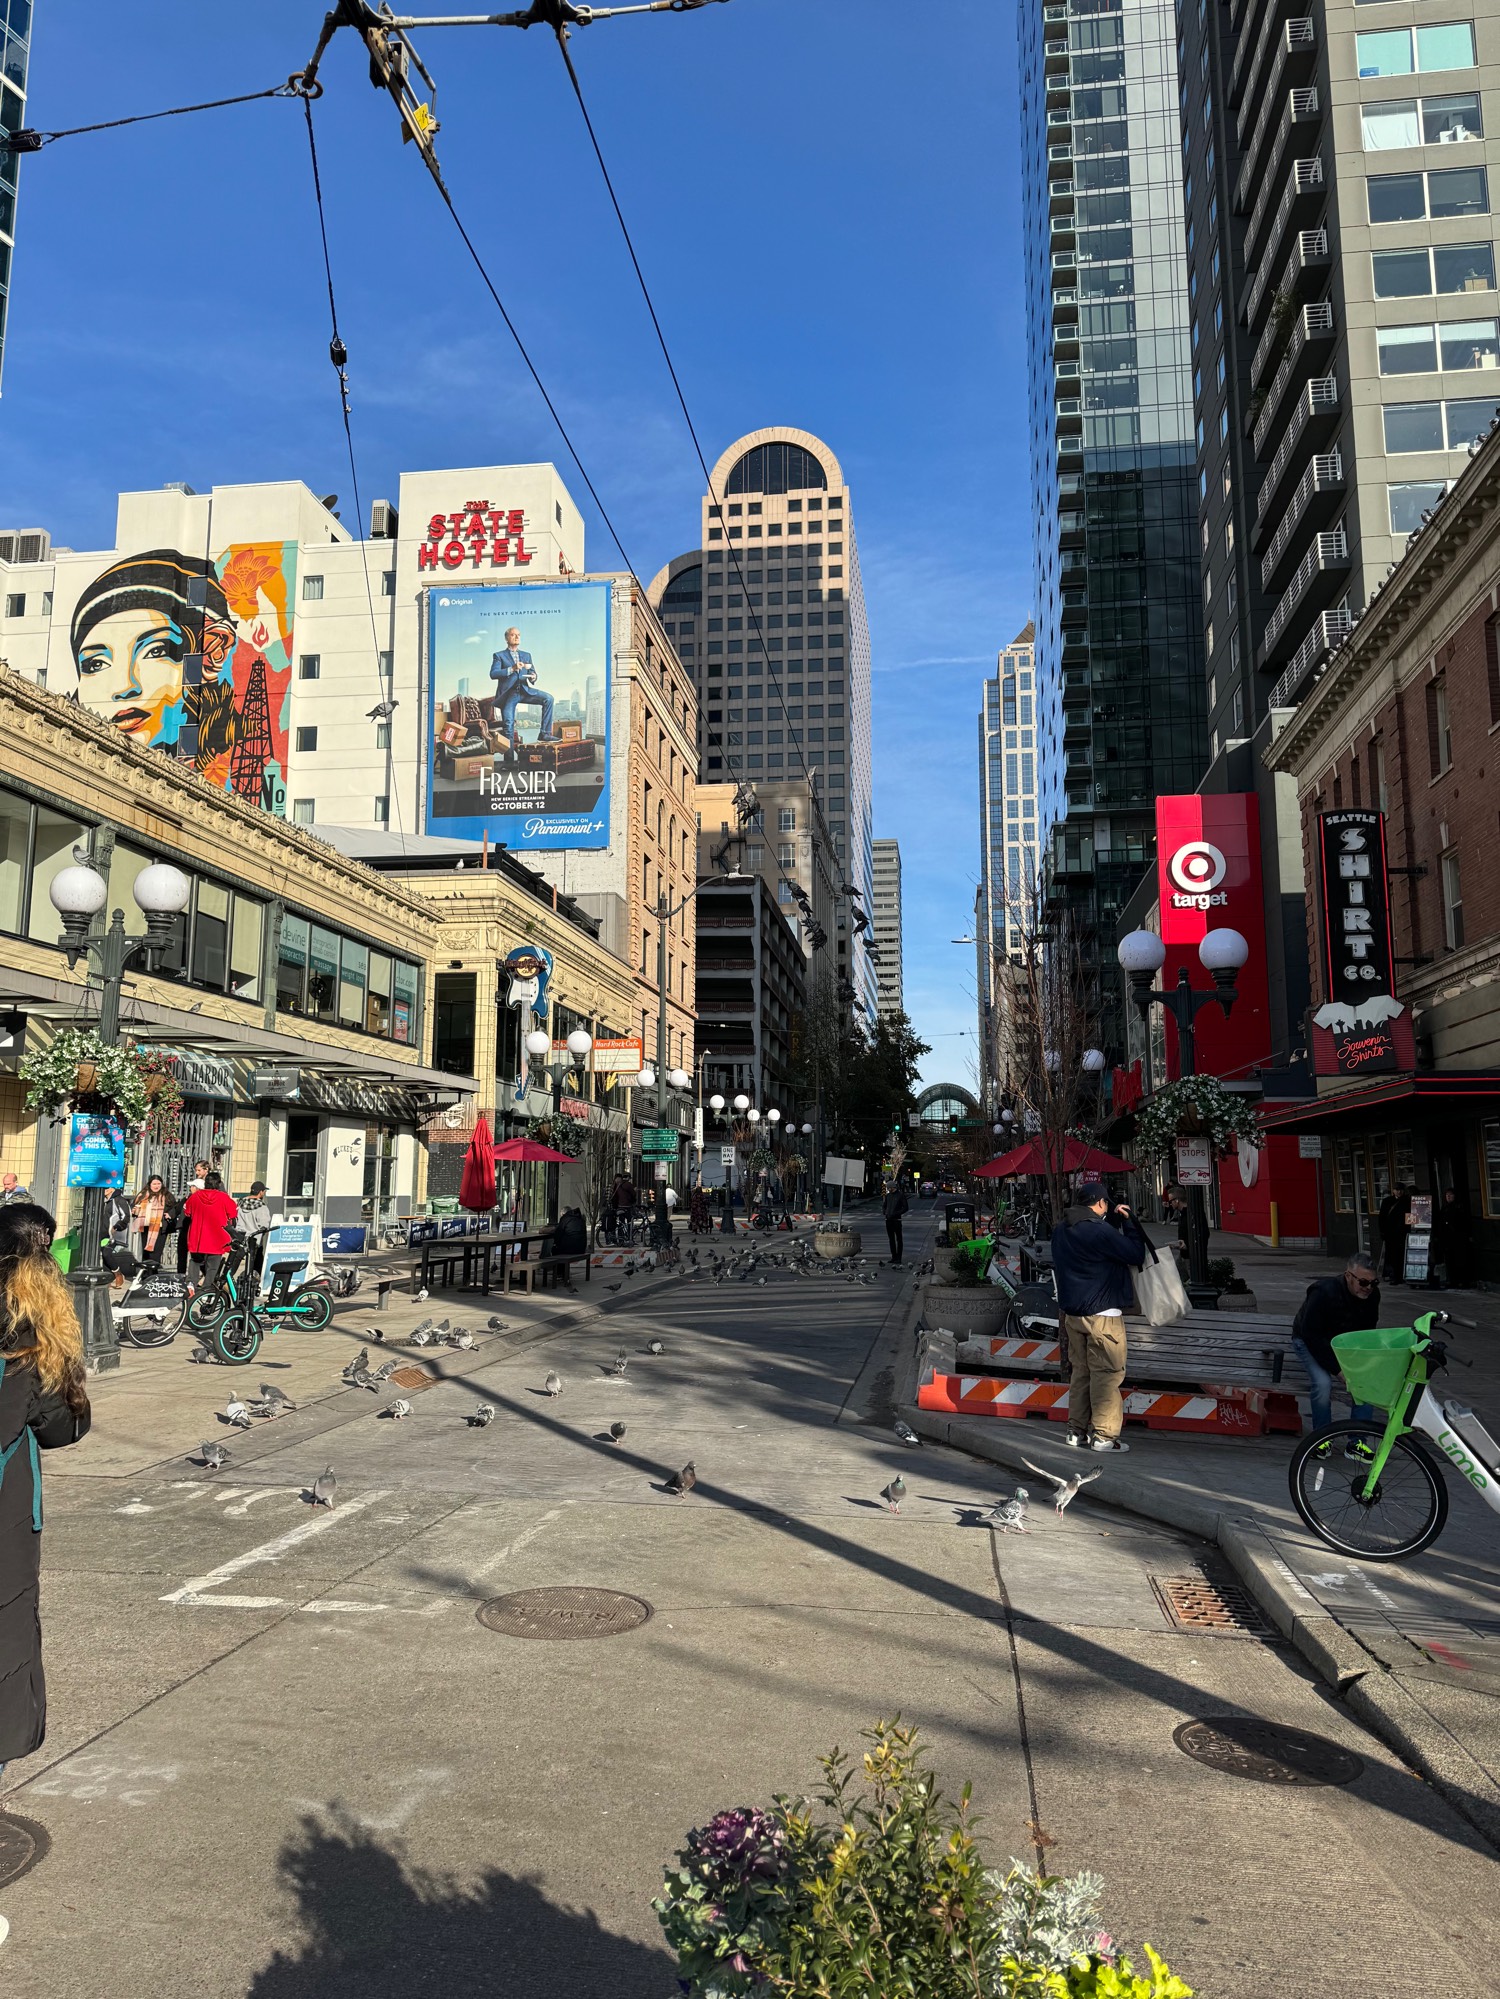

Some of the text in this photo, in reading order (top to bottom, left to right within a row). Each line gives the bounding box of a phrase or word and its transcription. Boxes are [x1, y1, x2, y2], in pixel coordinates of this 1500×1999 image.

[465, 500, 490, 511] THE
[428, 509, 525, 539] STATE
[420, 537, 532, 567] HOTEL
[451, 598, 473, 607] Original
[479, 766, 556, 796] FRASIER
[491, 801, 545, 811] OCTOBER 12
[522, 817, 605, 839] Paramount+
[1325, 813, 1377, 826] SEATTLE
[1172, 891, 1228, 910] target
[1338, 828, 1376, 960] SHIRT
[282, 927, 306, 947] devine
[1343, 964, 1382, 981] CO.
[611, 1040, 625, 1048] Rock
[625, 1039, 639, 1047] Cafe
[1337, 1033, 1392, 1059] Souvenir
[1346, 1046, 1394, 1069] Shirts
[191, 1062, 230, 1088] HARBOR
[180, 1082, 214, 1093] SEATTLE
[282, 1226, 305, 1235] devine
[271, 1280, 283, 1301] veo
[996, 1276, 1015, 1298] Lime
[1438, 1430, 1488, 1489] Lime
